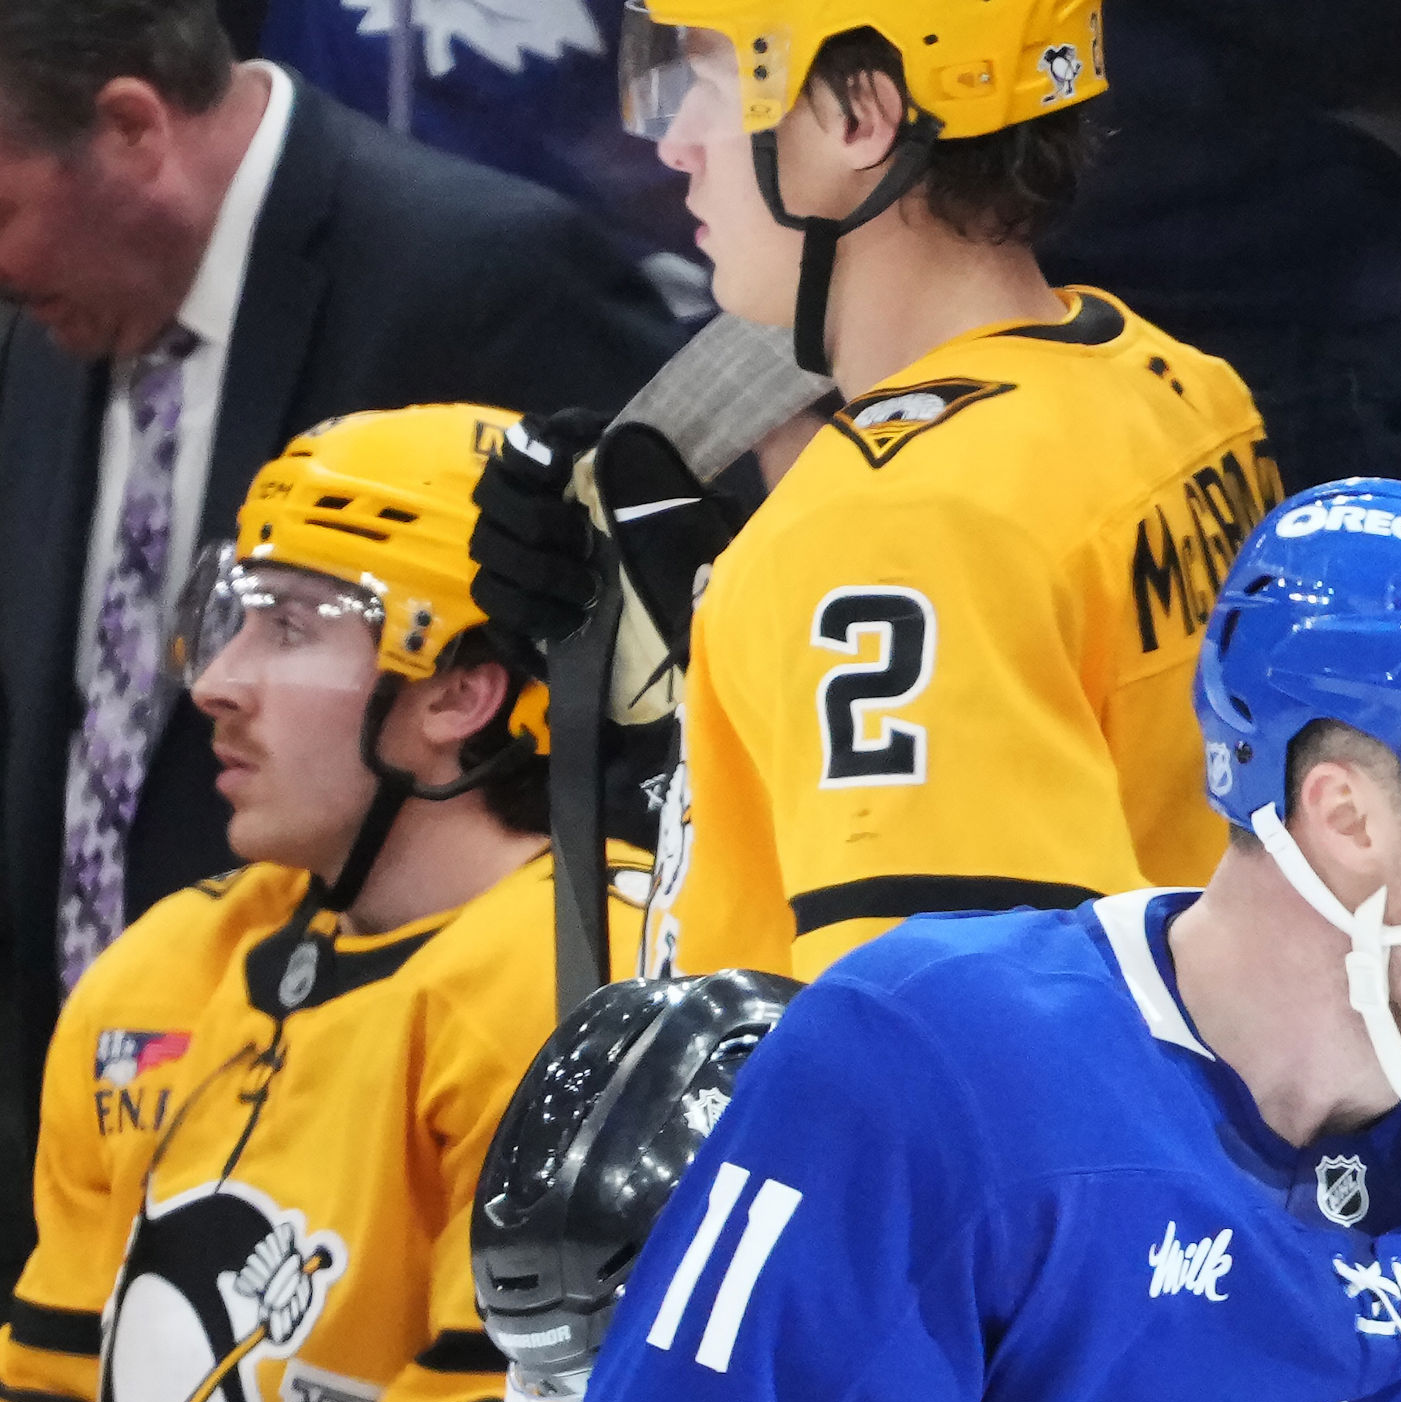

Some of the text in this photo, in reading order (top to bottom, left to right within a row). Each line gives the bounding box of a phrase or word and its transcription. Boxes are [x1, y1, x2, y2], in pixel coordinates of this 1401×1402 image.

[810, 585, 938, 790] 2
[646, 1161, 803, 1373] 11
[1149, 1220, 1234, 1301] Milk
